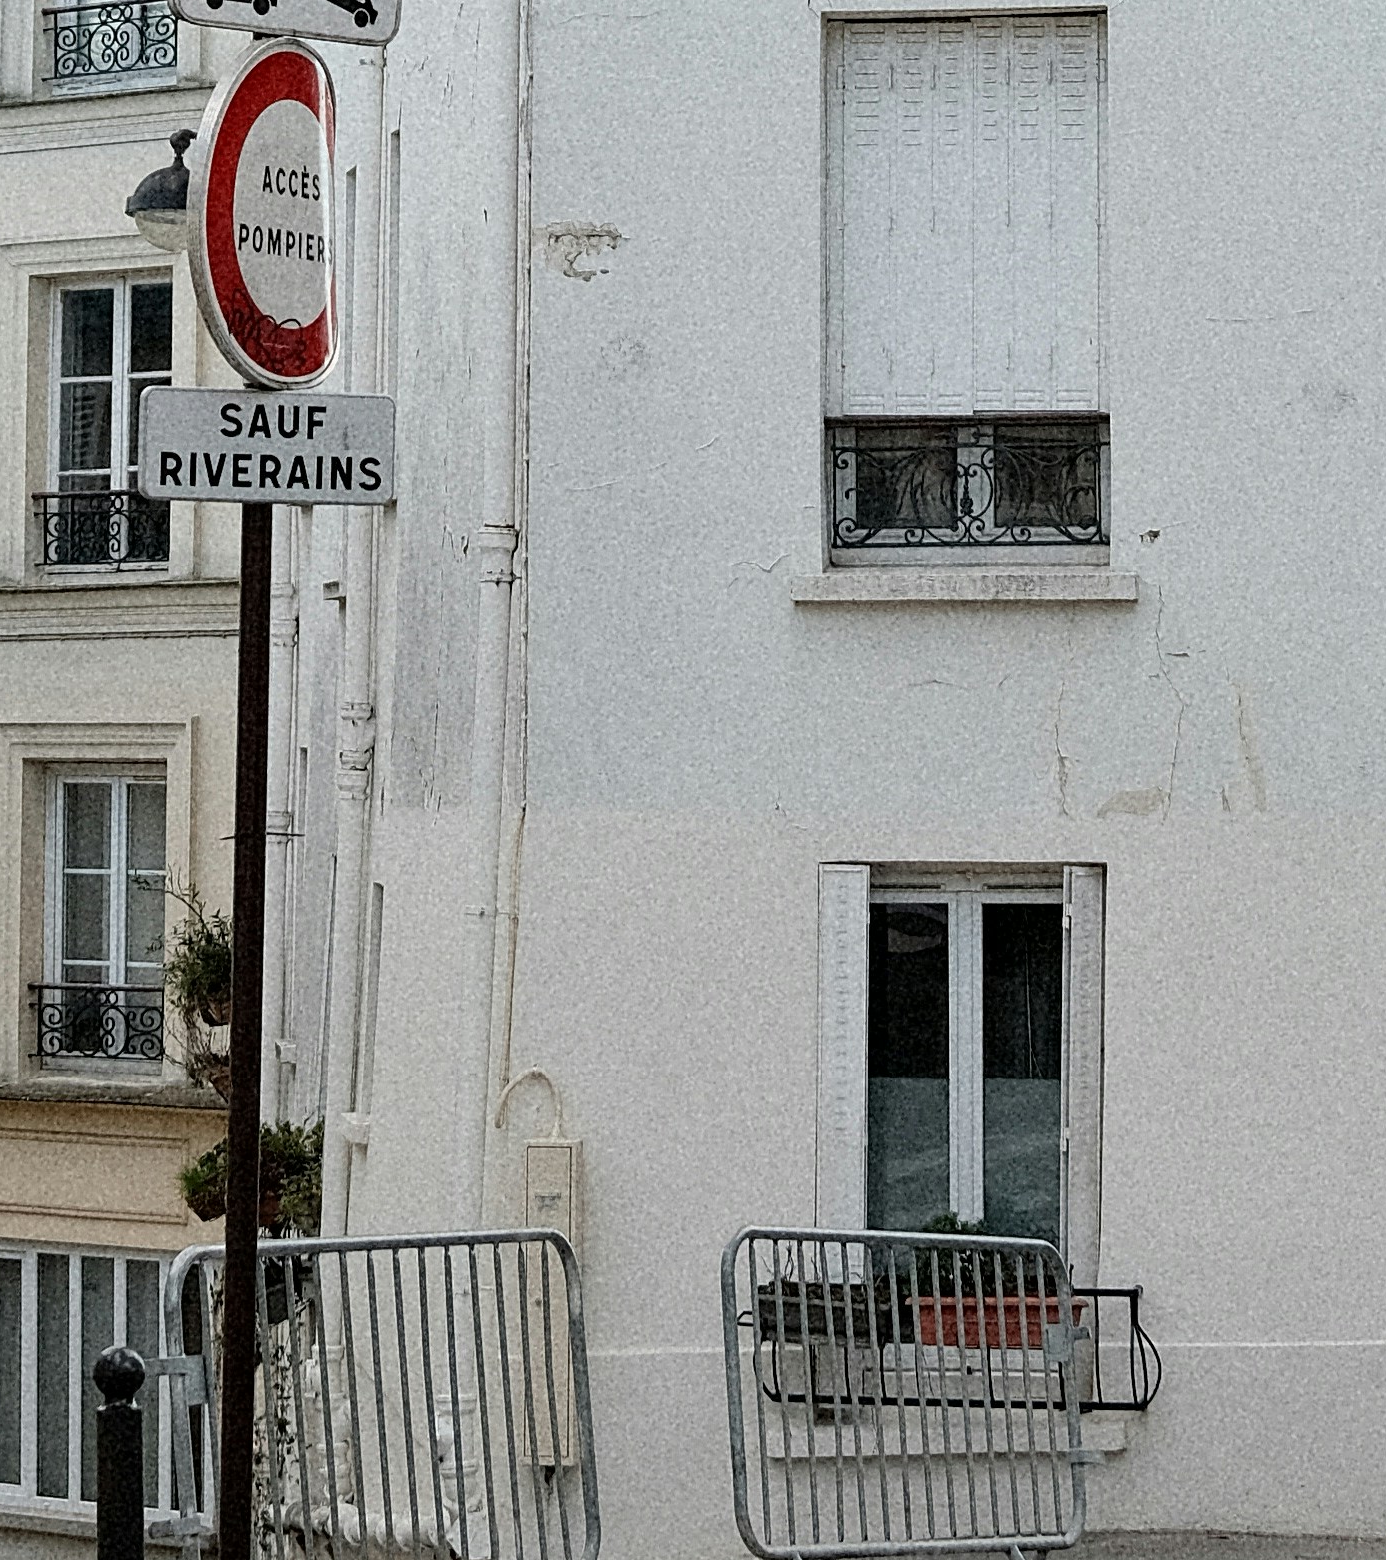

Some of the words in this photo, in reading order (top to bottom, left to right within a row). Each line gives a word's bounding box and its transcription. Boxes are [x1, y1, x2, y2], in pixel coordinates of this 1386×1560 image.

[262, 165, 321, 201] ACCÈS
[238, 222, 333, 266] POMPIERS
[220, 403, 327, 440] SAUF
[159, 451, 382, 492] RIVERAINS
